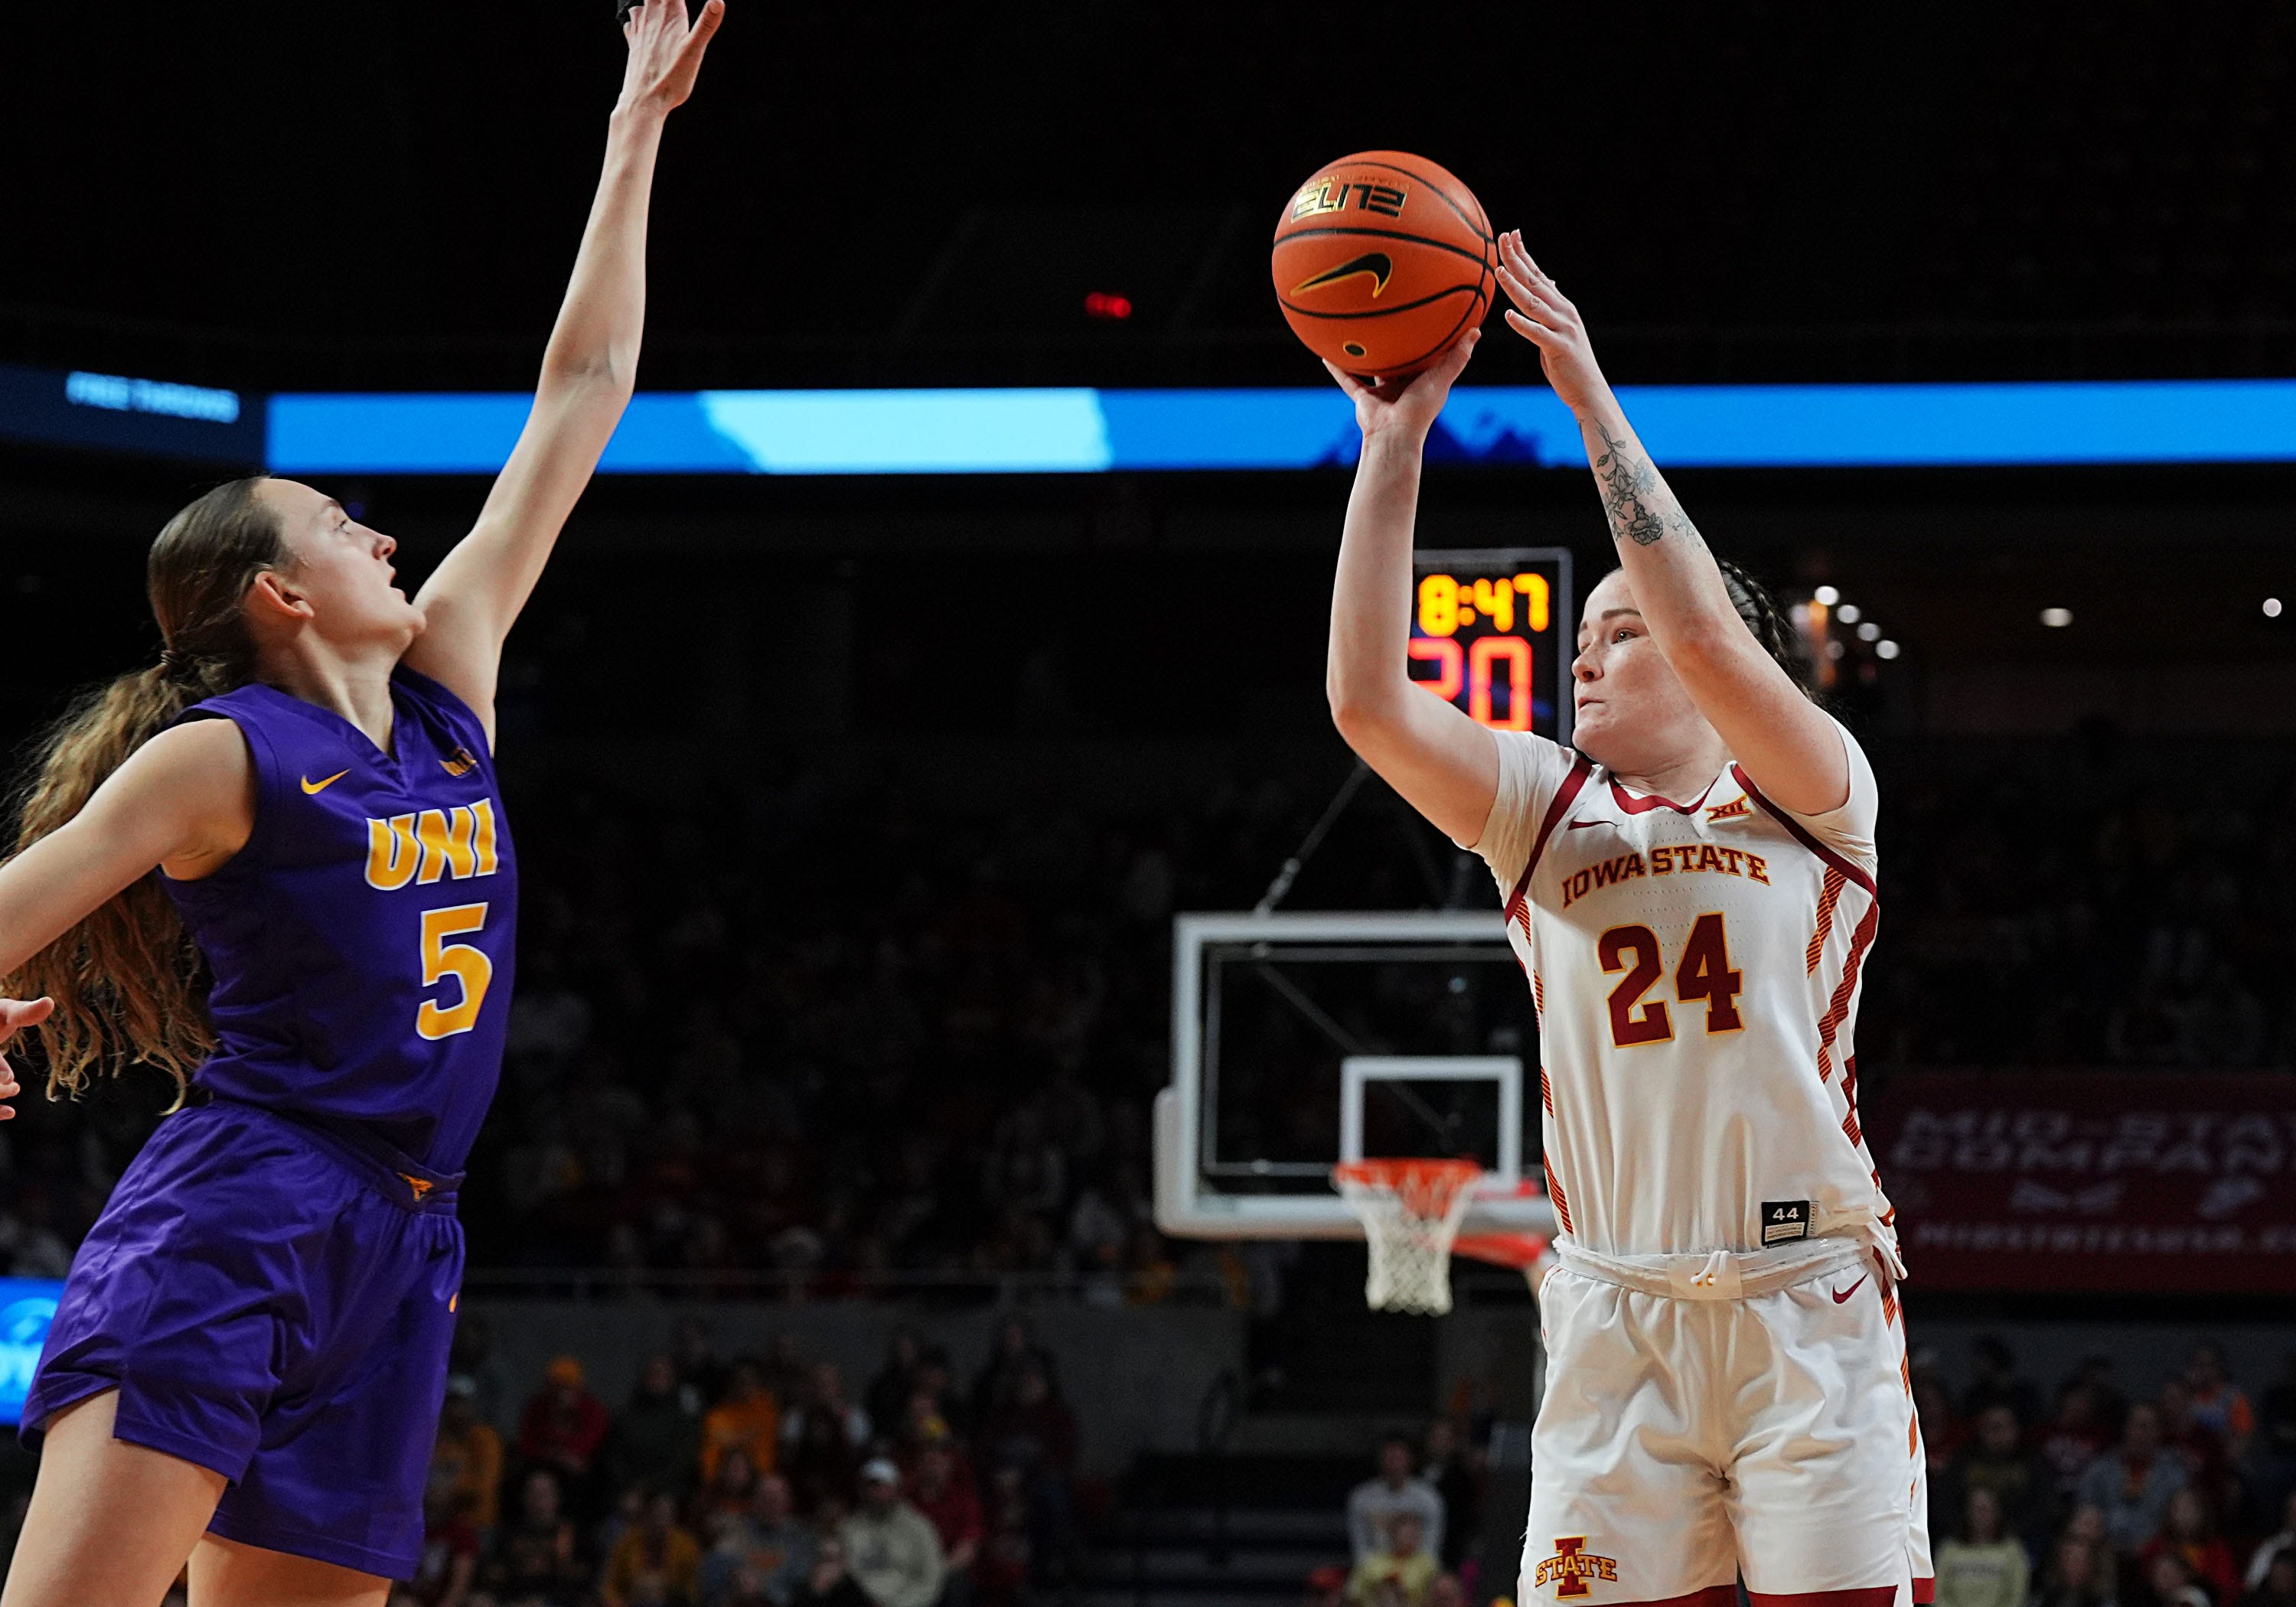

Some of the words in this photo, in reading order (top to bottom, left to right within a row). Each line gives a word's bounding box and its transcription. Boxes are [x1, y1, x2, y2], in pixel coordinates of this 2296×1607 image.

[1290, 182, 1408, 224] ELITE
[1418, 572, 1550, 637] 8:47
[364, 797, 499, 892] UNI
[1562, 852, 1647, 909] IOWA
[1650, 843, 1772, 886] STATE
[416, 901, 493, 1041] 5
[1597, 911, 1746, 1048] 24
[1898, 1110, 2296, 1143] MID-STA
[1890, 1139, 2296, 1174] COMPAN
[1773, 1208, 1799, 1221] 44
[1535, 1554, 1618, 1588] STATE
